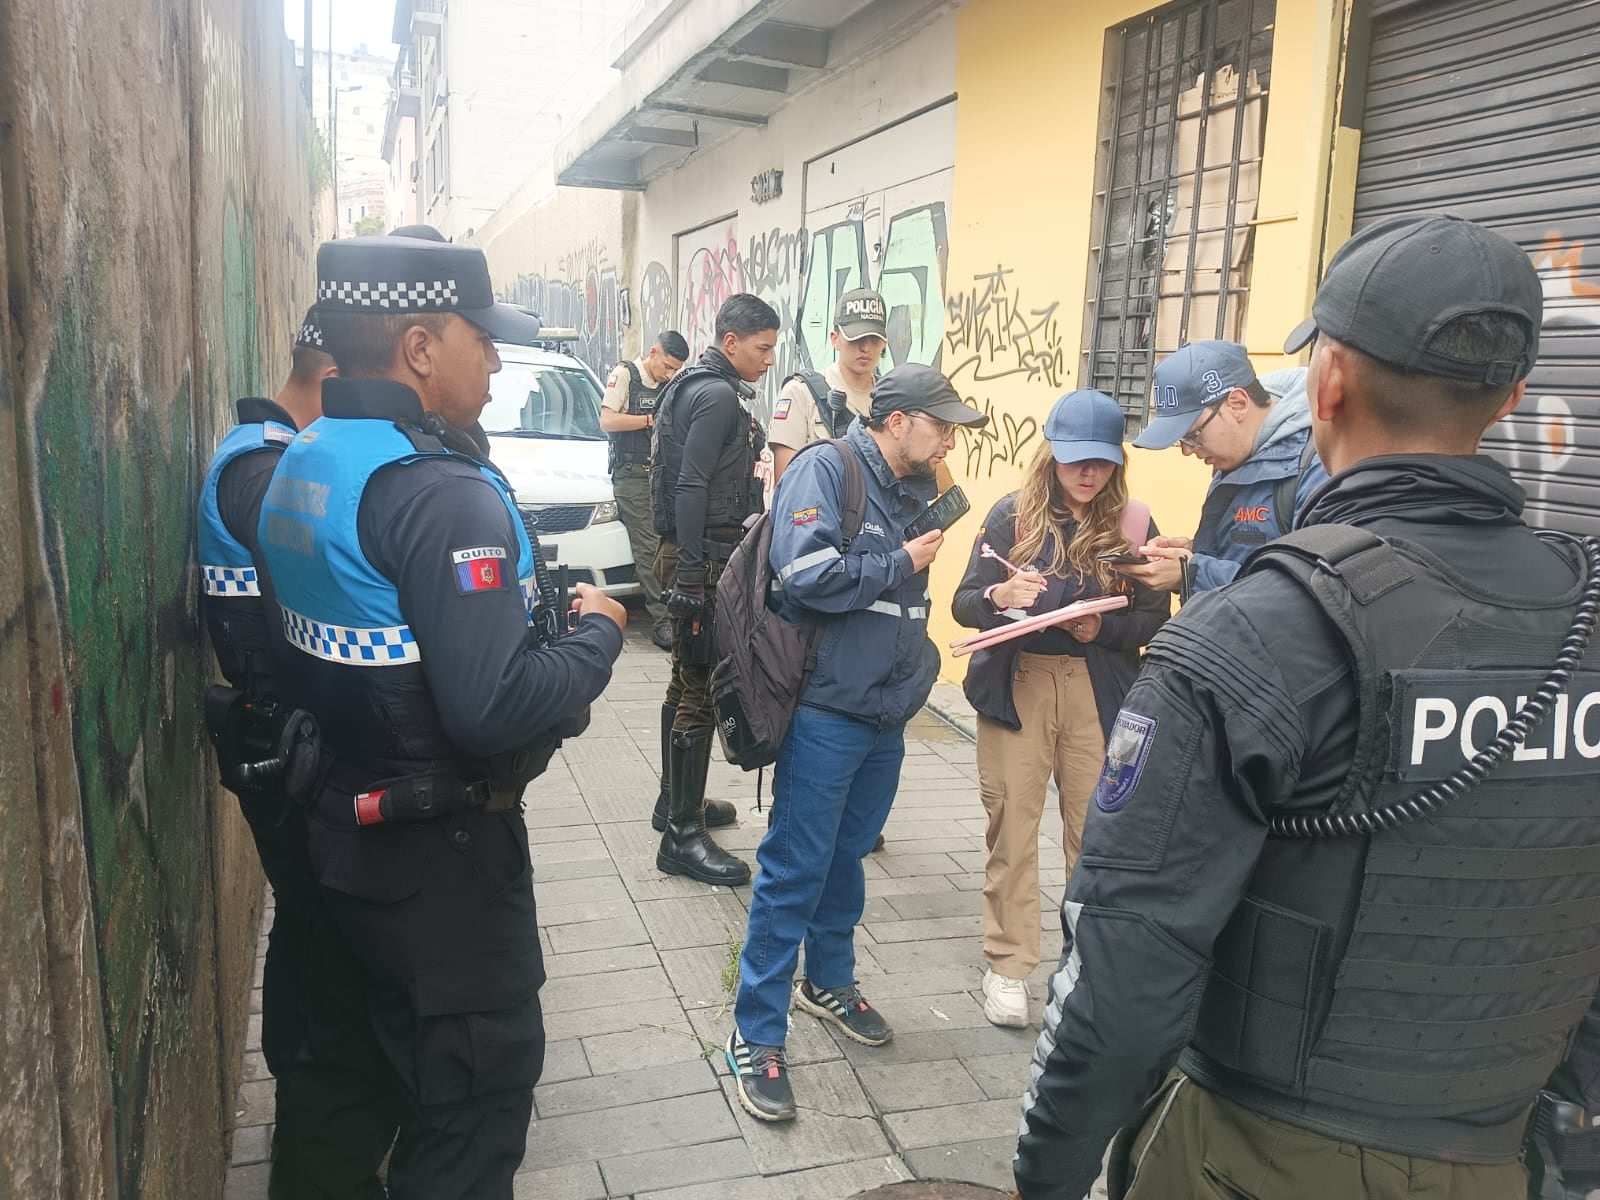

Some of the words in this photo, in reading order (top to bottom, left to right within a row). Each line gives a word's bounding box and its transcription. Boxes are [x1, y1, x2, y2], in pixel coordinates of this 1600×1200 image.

[1202, 369, 1223, 393] 3
[1234, 506, 1270, 522] AMC
[461, 549, 502, 559] QUITO
